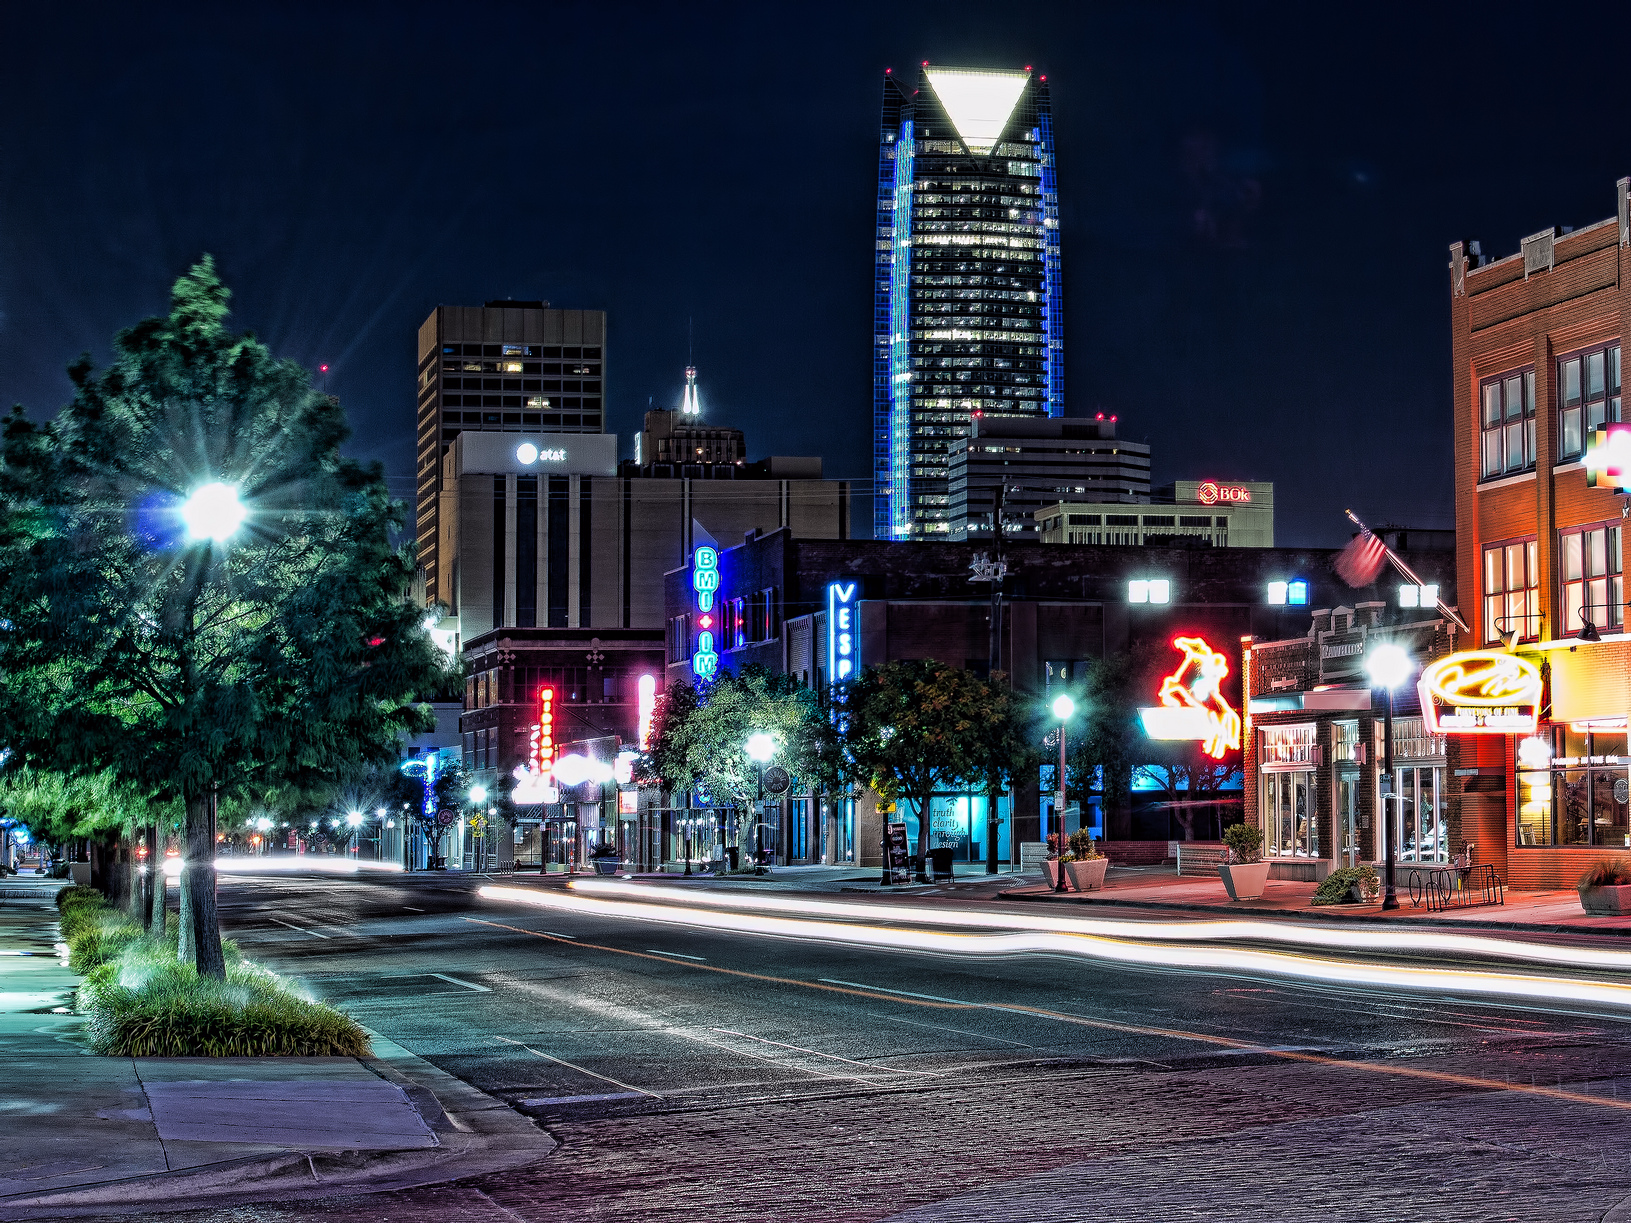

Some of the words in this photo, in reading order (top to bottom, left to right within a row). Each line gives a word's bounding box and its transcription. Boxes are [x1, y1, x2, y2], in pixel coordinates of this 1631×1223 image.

[1220, 487, 1250, 501] BOk
[1321, 642, 1363, 659] RAWHIDE
[932, 807, 955, 817] truth
[932, 817, 959, 831] clarity
[932, 828, 966, 842] through
[932, 839, 959, 850] design
